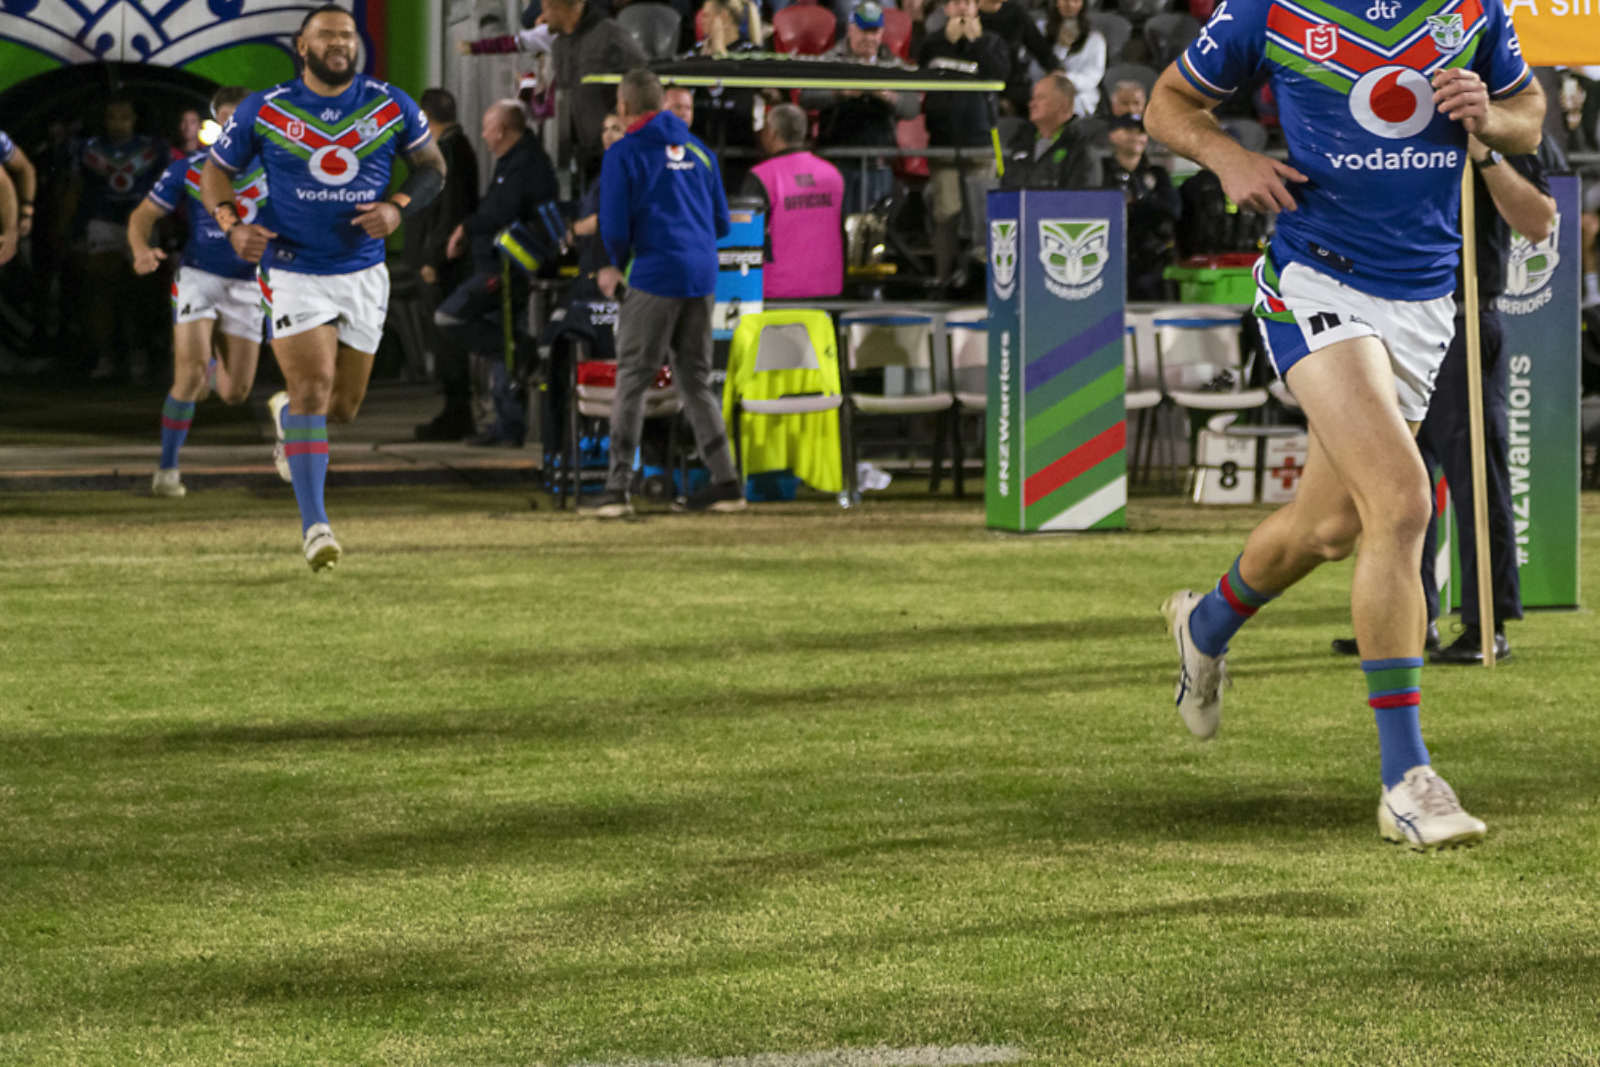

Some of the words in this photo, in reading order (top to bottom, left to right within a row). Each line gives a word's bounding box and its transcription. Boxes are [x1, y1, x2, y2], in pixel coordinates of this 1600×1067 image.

[1325, 146, 1458, 170] vodafone
[296, 187, 377, 202] vodafone
[1220, 460, 1238, 488] 8
